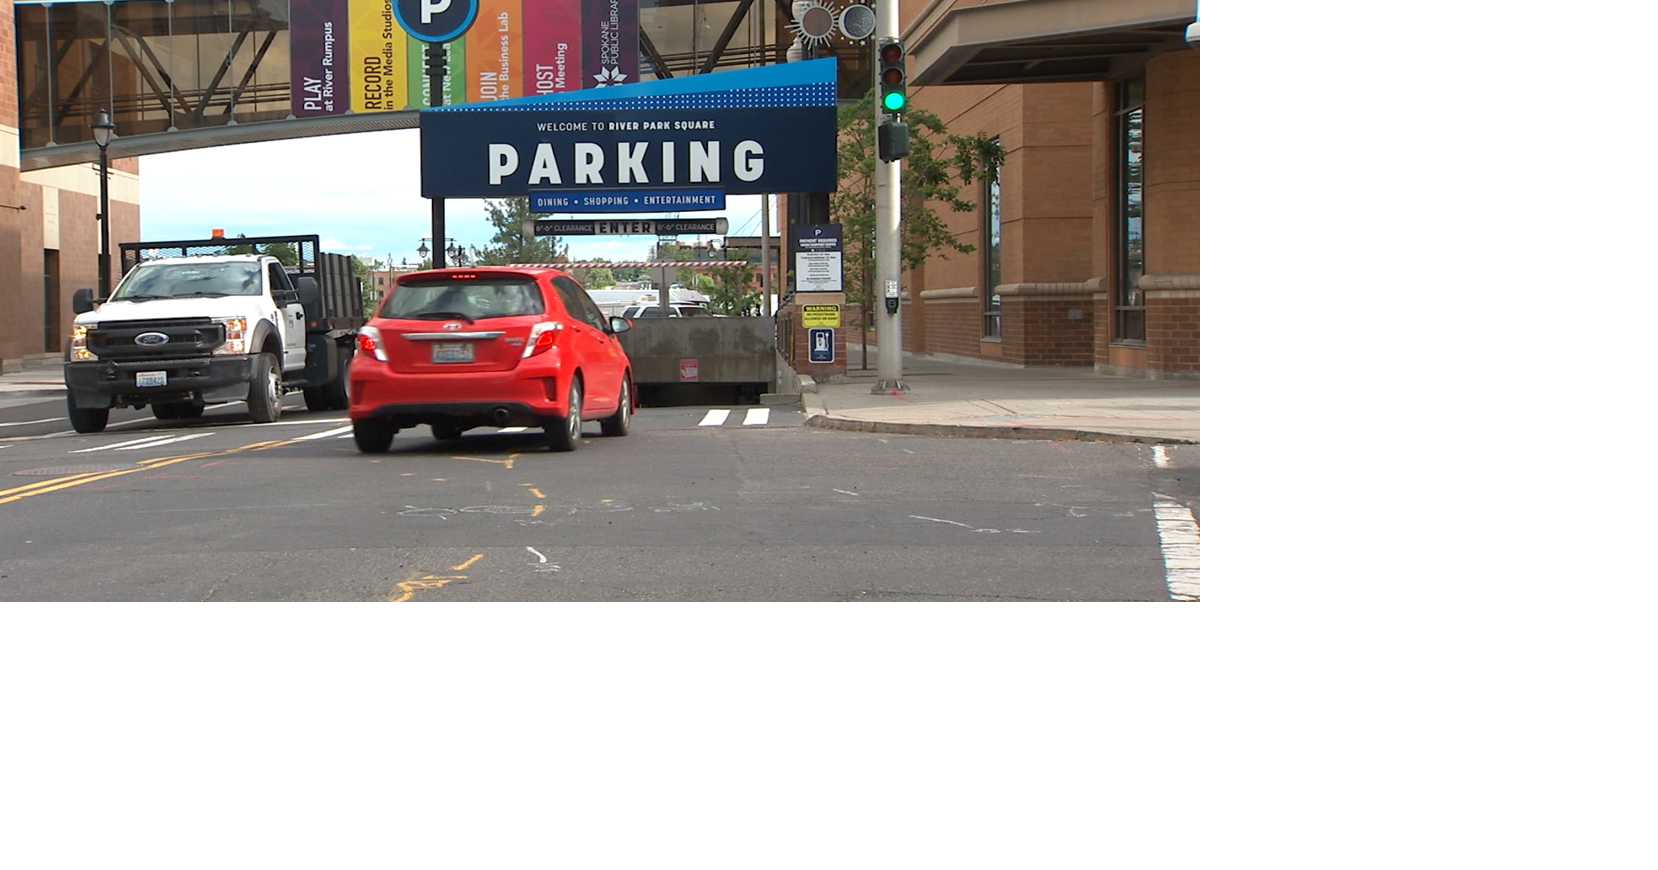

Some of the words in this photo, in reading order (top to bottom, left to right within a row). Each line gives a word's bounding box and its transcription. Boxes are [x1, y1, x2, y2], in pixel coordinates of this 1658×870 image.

[381, 0, 393, 39] Studios
[421, 0, 452, 24] P
[497, 12, 509, 32] Lab
[322, 22, 336, 66] Rumpus
[601, 20, 610, 65] SPOKANE
[610, 32, 619, 65] PUBLIC
[382, 42, 393, 76] Media
[498, 34, 510, 81] Business
[555, 42, 568, 88] Meeting
[303, 76, 322, 110] PLAY
[322, 69, 333, 97] River
[364, 56, 382, 110] RECORD
[383, 79, 394, 98] the
[480, 71, 498, 101] JOIN
[323, 101, 334, 112] at
[384, 101, 394, 110] in
[443, 94, 452, 106] at
[537, 122, 588, 132] WELCOME
[592, 122, 605, 131] TO
[608, 121, 639, 131] RIVER
[643, 121, 671, 130] PARK
[674, 120, 716, 131] SQUARE
[488, 139, 765, 185] PARKING
[537, 197, 569, 207] DINING
[583, 196, 629, 206] SHOPPING
[643, 195, 716, 205] ENTERTAINMENT
[554, 224, 593, 232] CLEARANCE
[600, 222, 651, 233] ENTER
[676, 223, 715, 231] CLEARANCE
